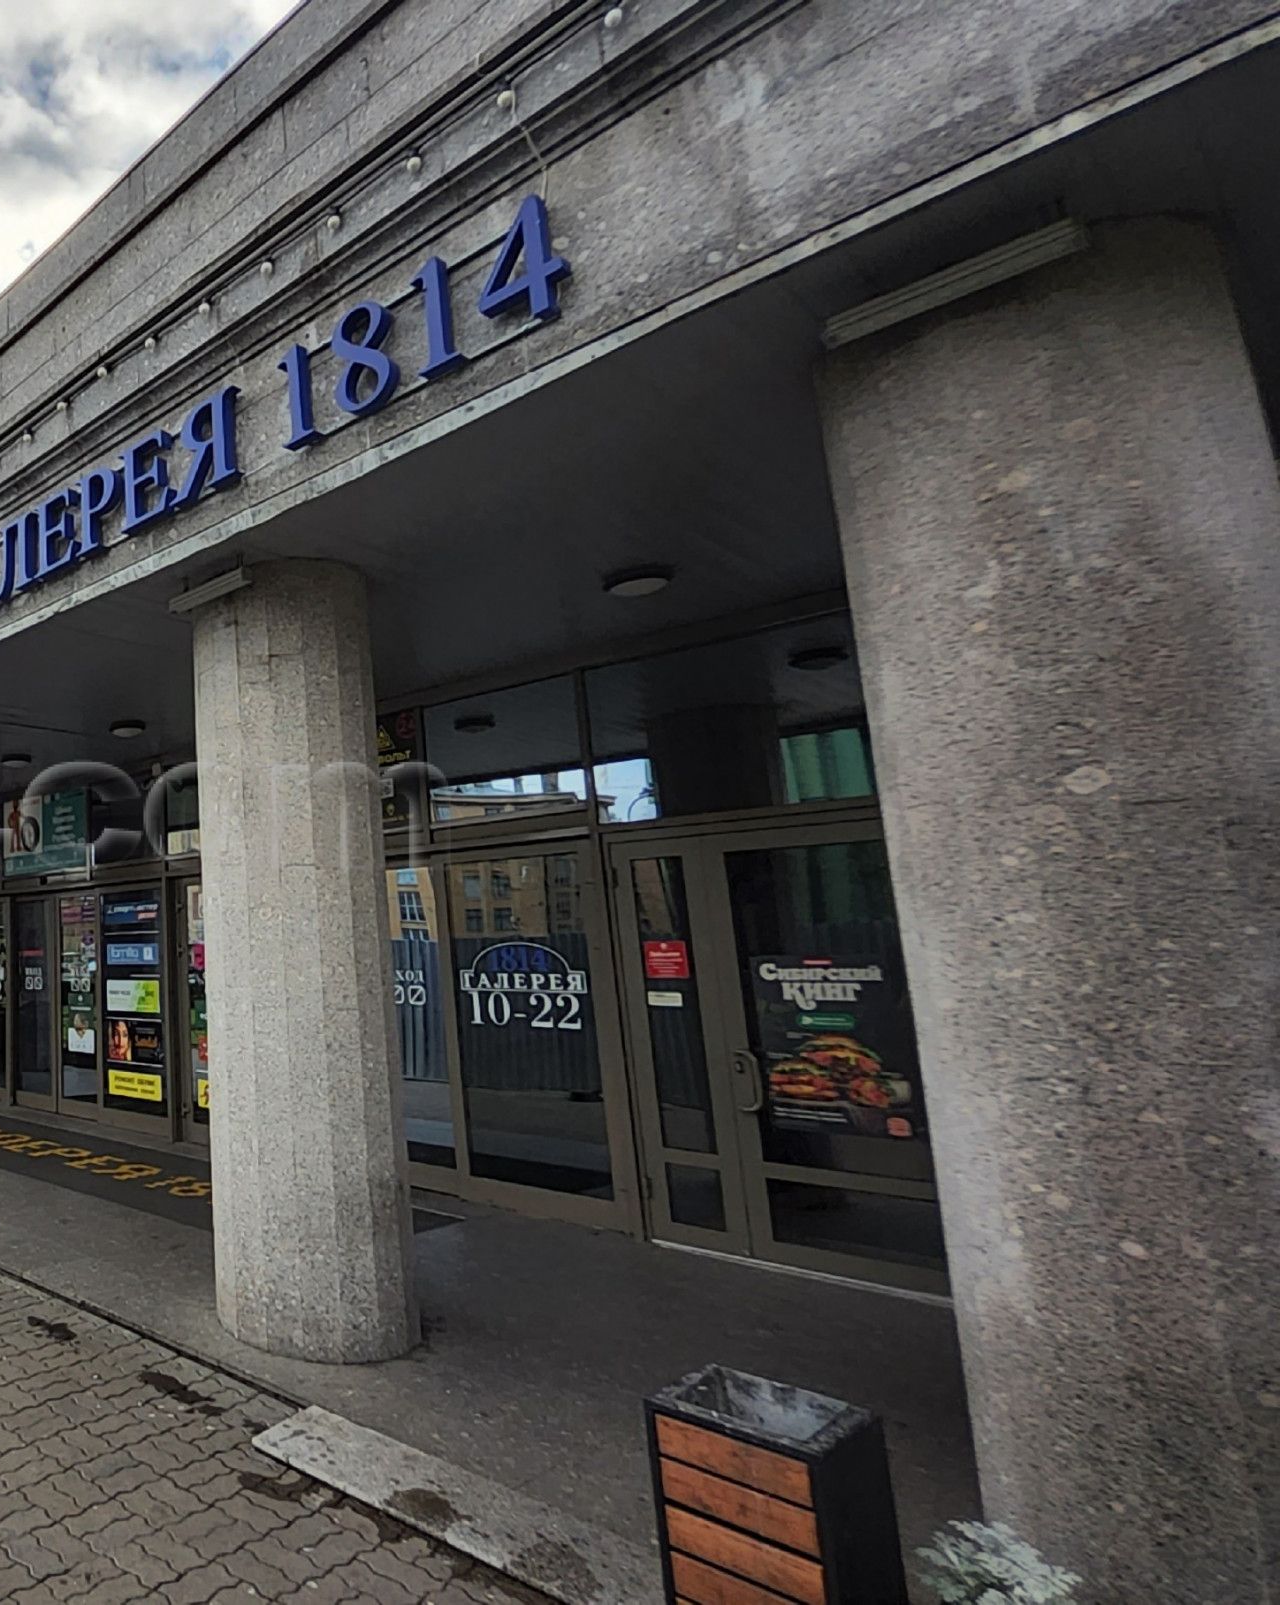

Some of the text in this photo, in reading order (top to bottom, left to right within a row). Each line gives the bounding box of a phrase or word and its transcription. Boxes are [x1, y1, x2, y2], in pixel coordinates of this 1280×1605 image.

[276, 193, 572, 452] 1814
[462, 969, 585, 993] ГАЛЕРЕЯ
[469, 991, 583, 1030] 10-22
